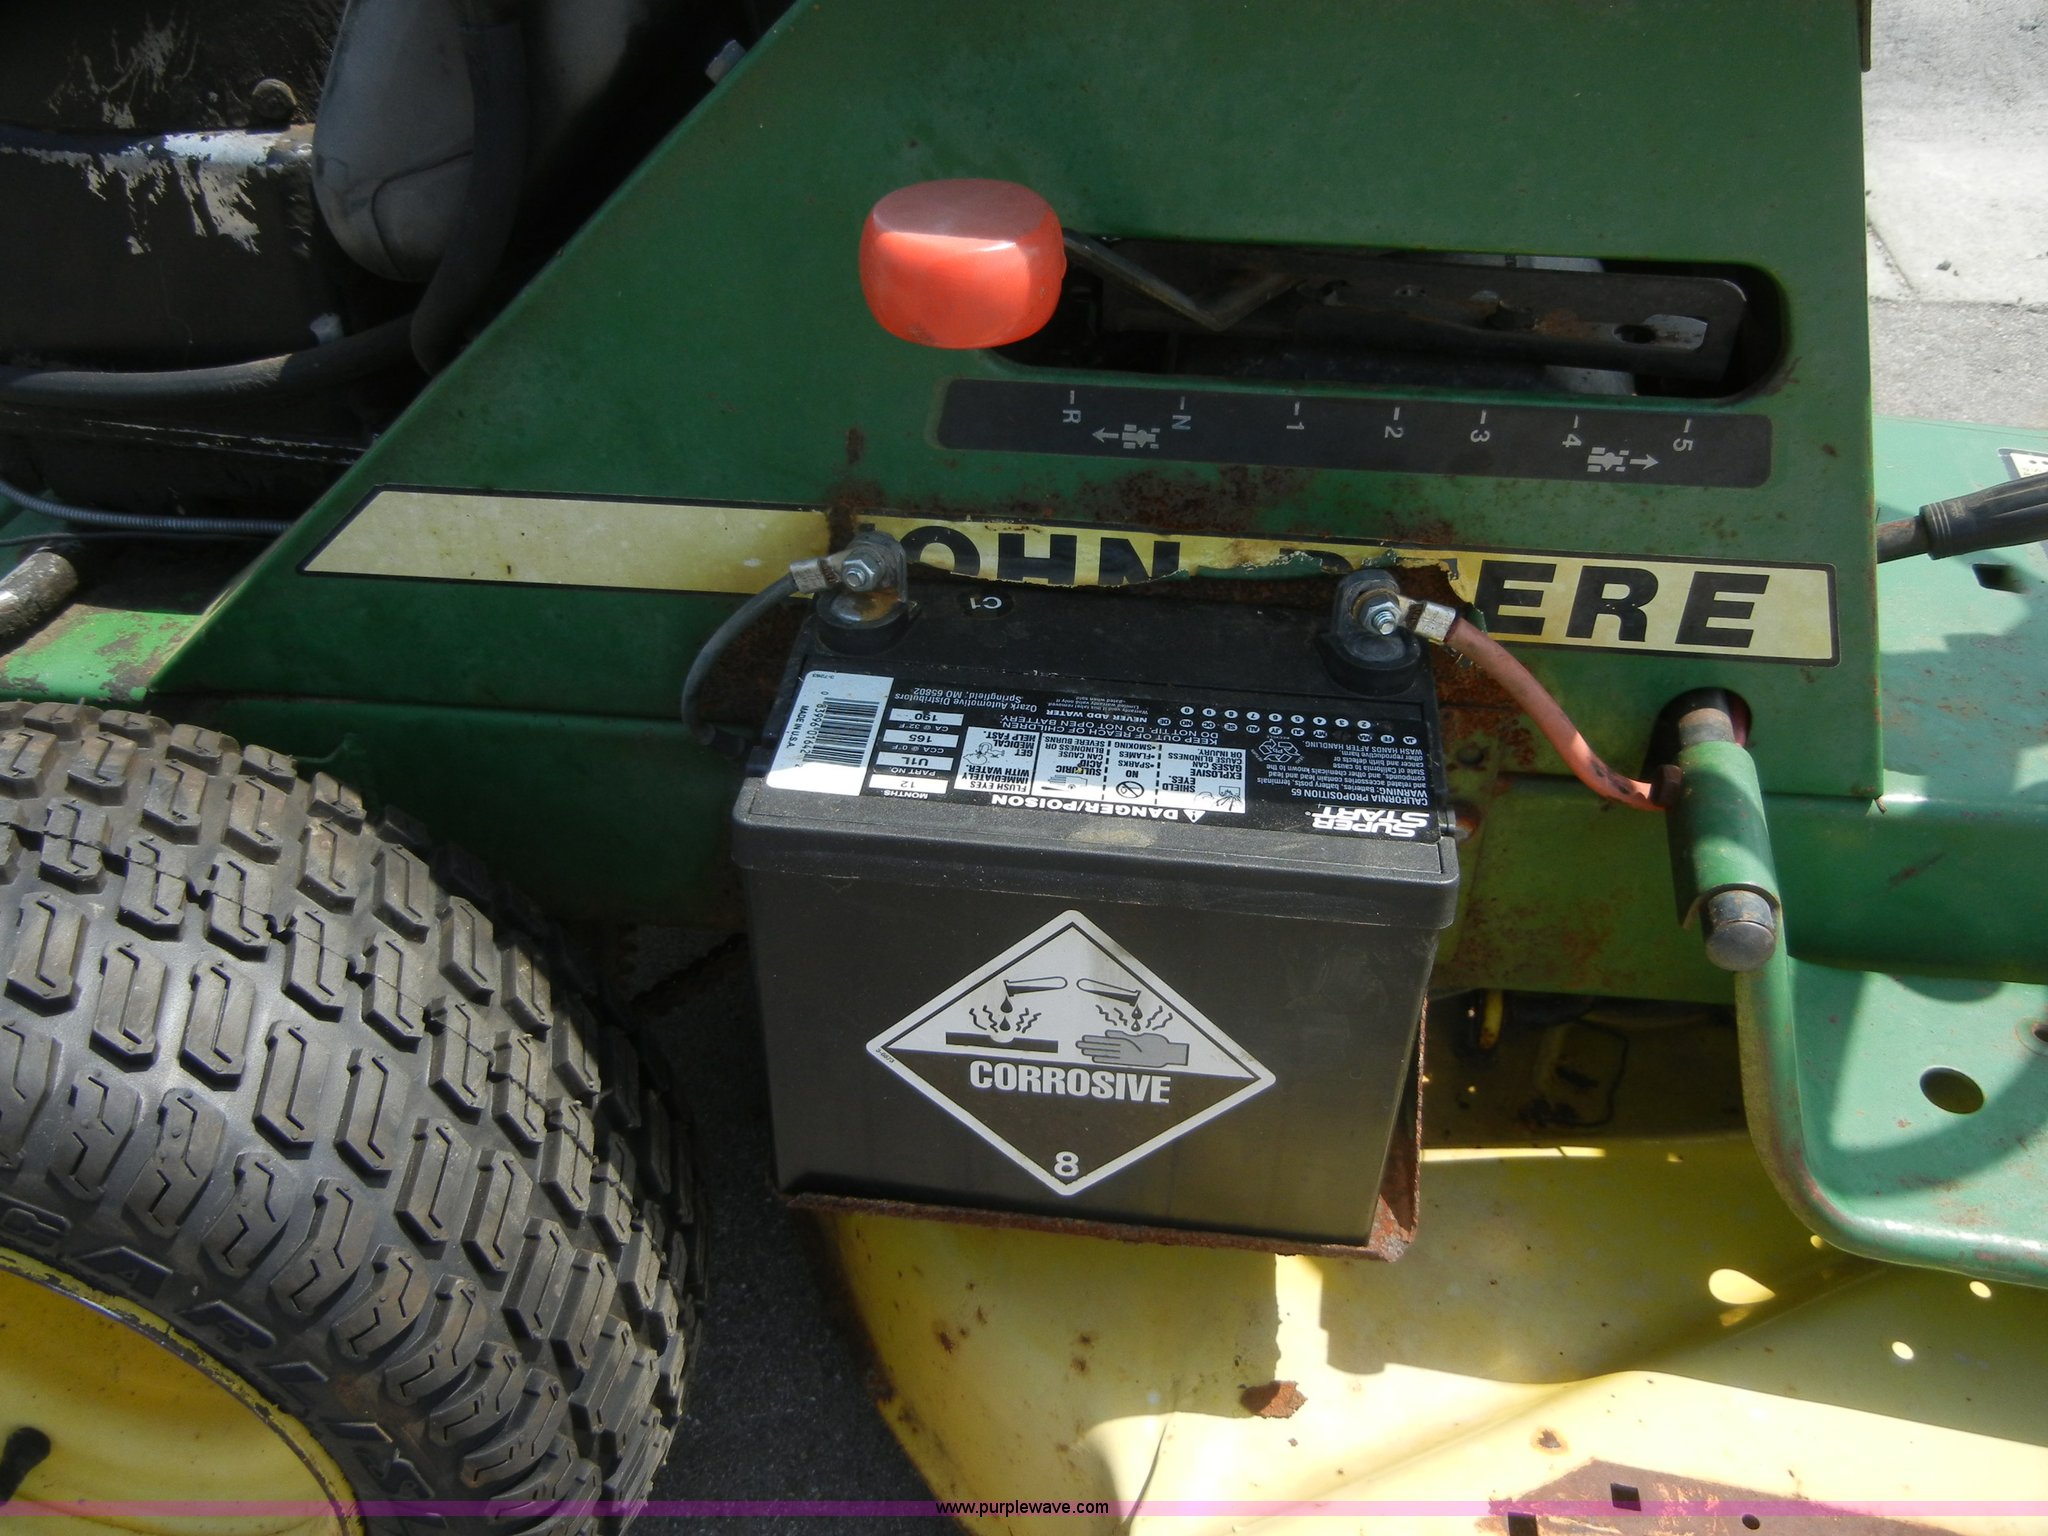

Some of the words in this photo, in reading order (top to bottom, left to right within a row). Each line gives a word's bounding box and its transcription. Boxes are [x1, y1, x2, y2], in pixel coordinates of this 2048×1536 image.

[1063, 409, 1081, 424] R
[1171, 414, 1192, 430] N
[1286, 422, 1305, 432] 1
[1384, 425, 1404, 440] 2
[1470, 429, 1490, 444] 3
[1562, 432, 1583, 449] 4
[1672, 437, 1693, 453] 5
[866, 523, 1180, 585] OHN
[969, 597, 1003, 610] C1
[914, 688, 943, 696] 65802
[895, 693, 950, 705] Distributors
[953, 699, 1008, 709] Automotive
[1010, 703, 1037, 712] Ozark
[796, 705, 809, 722] MADE
[1046, 710, 1083, 718] WATER
[1113, 714, 1147, 722] NEVER
[1001, 714, 1056, 726] BATTERY.
[1061, 720, 1094, 728] OPEN
[1000, 721, 1064, 732] CHILDREN.
[1098, 723, 1122, 731] NOT
[908, 734, 932, 743] 165
[984, 731, 1009, 740] FAST.
[1011, 733, 1035, 742] HELP
[1089, 729, 1131, 739] REACH
[993, 739, 1034, 749] MEDICAL
[1043, 736, 1071, 744] BURNS.
[1074, 738, 1105, 747] SEVERE
[1184, 737, 1218, 745] KEEP
[1302, 740, 1344, 749] HANDLING.
[1015, 749, 1033, 757] GET
[1059, 744, 1104, 753] BLINDNESS
[1197, 749, 1228, 757] INJURY.
[901, 757, 929, 766] U1L
[1168, 753, 1213, 762] BLINDNESS
[1079, 760, 1102, 768] ACID
[1211, 763, 1242, 771] GASES
[966, 765, 997, 774] WATER.
[1001, 767, 1029, 776] WITH
[1311, 768, 1347, 776] chemicals
[1363, 765, 1396, 773] California
[962, 773, 1028, 784] IMMEDIATELY
[1126, 770, 1139, 778] NO
[1190, 769, 1242, 780] EXPLOSIVE
[1168, 775, 1195, 784] EYES.
[1387, 780, 1411, 788] related
[970, 781, 994, 789] EYES
[998, 783, 1026, 792] FLUSH
[1162, 783, 1195, 792] SHIELD
[1315, 781, 1339, 790] battery
[883, 790, 928, 799] MONTHS
[1291, 788, 1302, 796] 65
[1304, 789, 1368, 801] PROPOSITION
[1377, 787, 1427, 797] WARNING:
[1371, 794, 1428, 806] CALIFORNIA
[991, 794, 1179, 820] DANGER/POISON
[1311, 807, 1429, 827] START
[1312, 817, 1415, 837] SUPER
[969, 1060, 1171, 1104] CORROSIVE
[1054, 1151, 1079, 1177] 8
